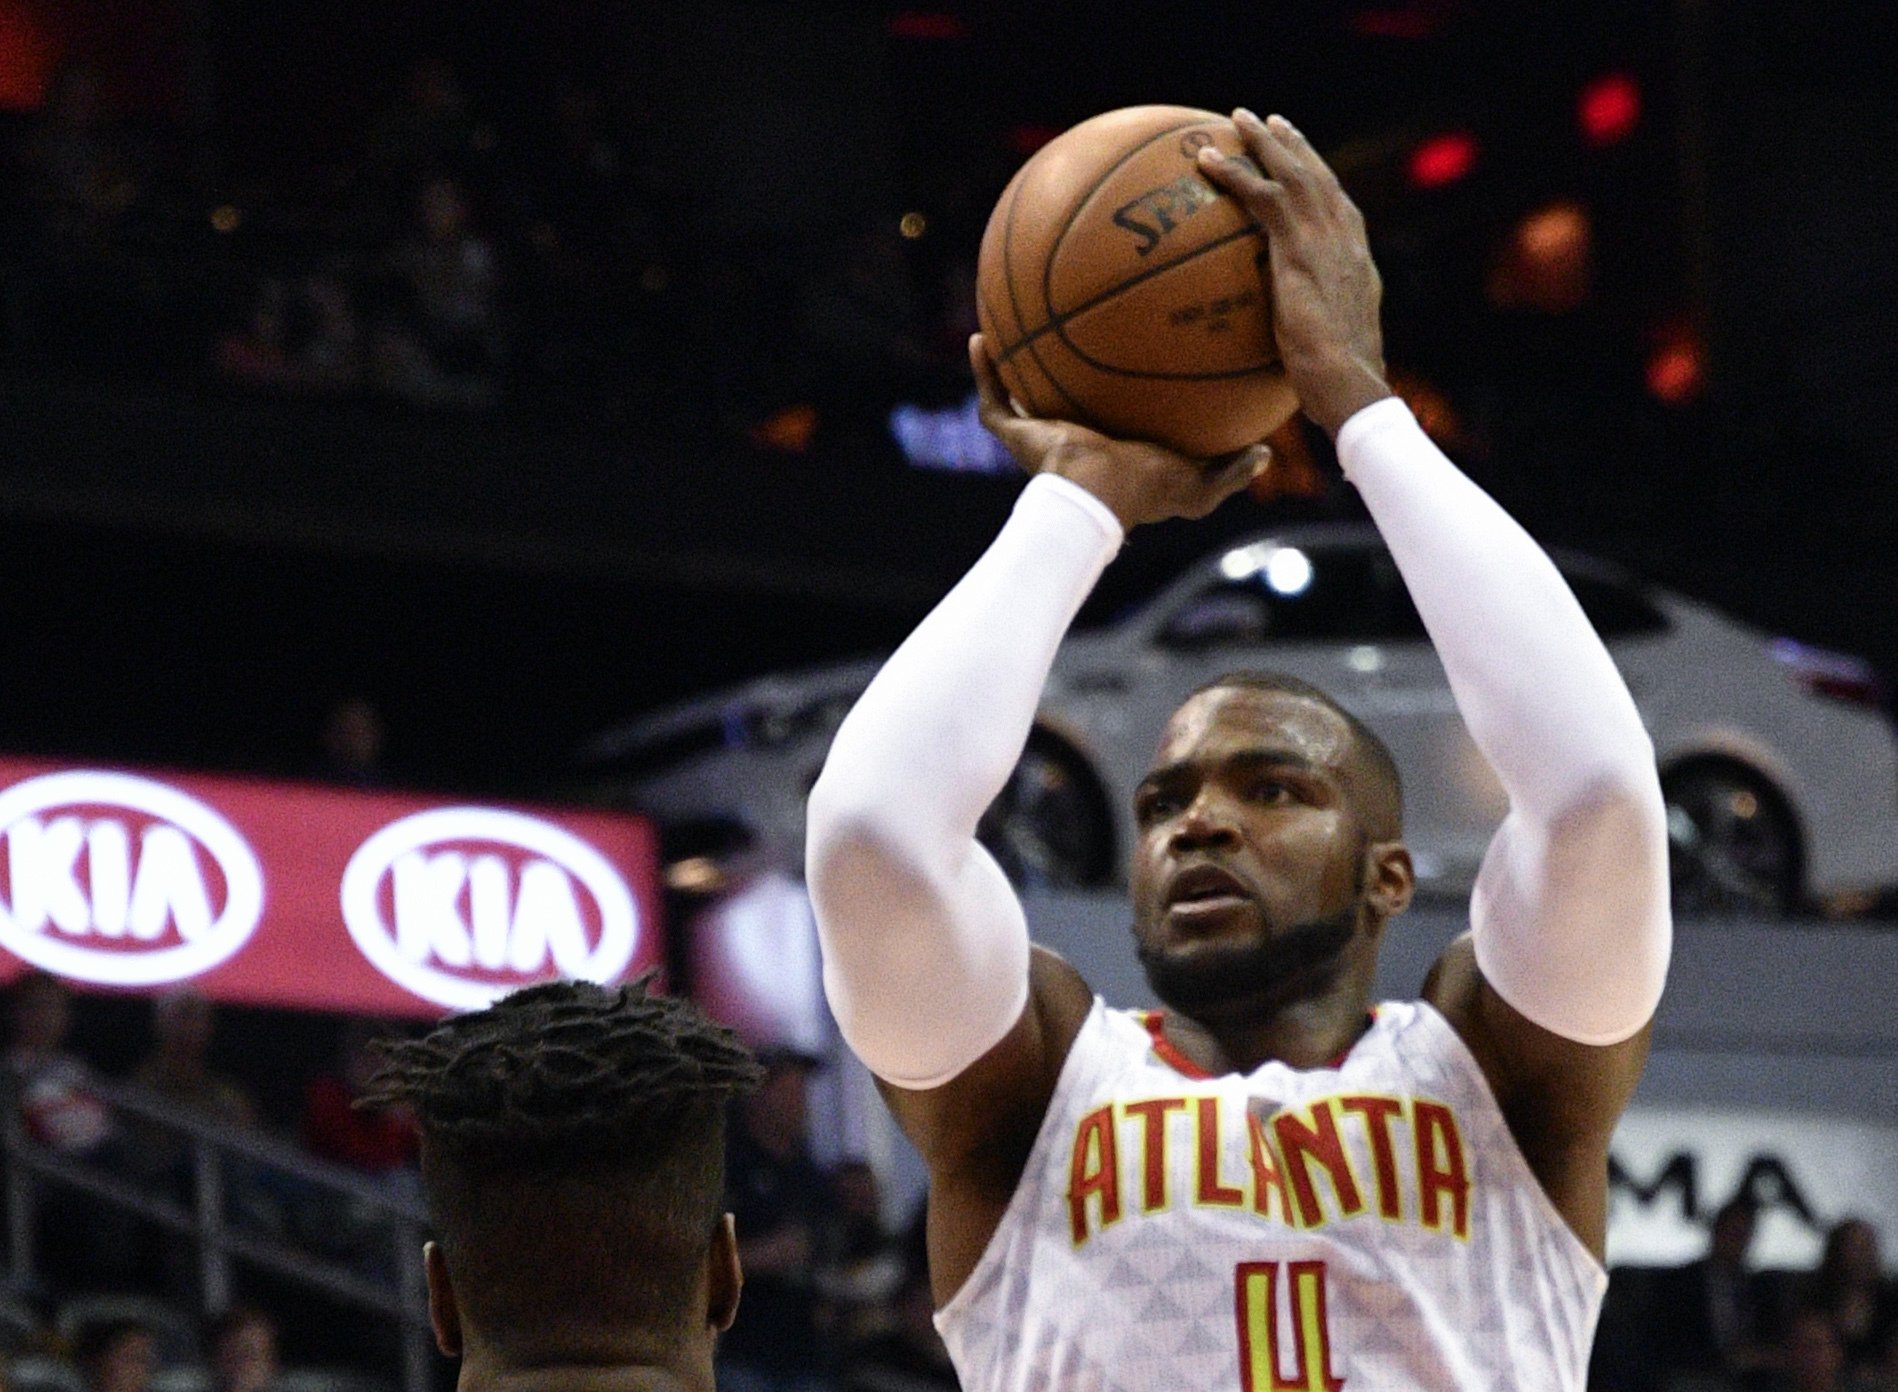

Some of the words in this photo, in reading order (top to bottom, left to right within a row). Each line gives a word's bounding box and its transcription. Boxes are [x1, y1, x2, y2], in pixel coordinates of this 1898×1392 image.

[5, 814, 216, 942] KIA
[391, 850, 596, 976] KIA
[1067, 1095, 1471, 1248] ATLANTA
